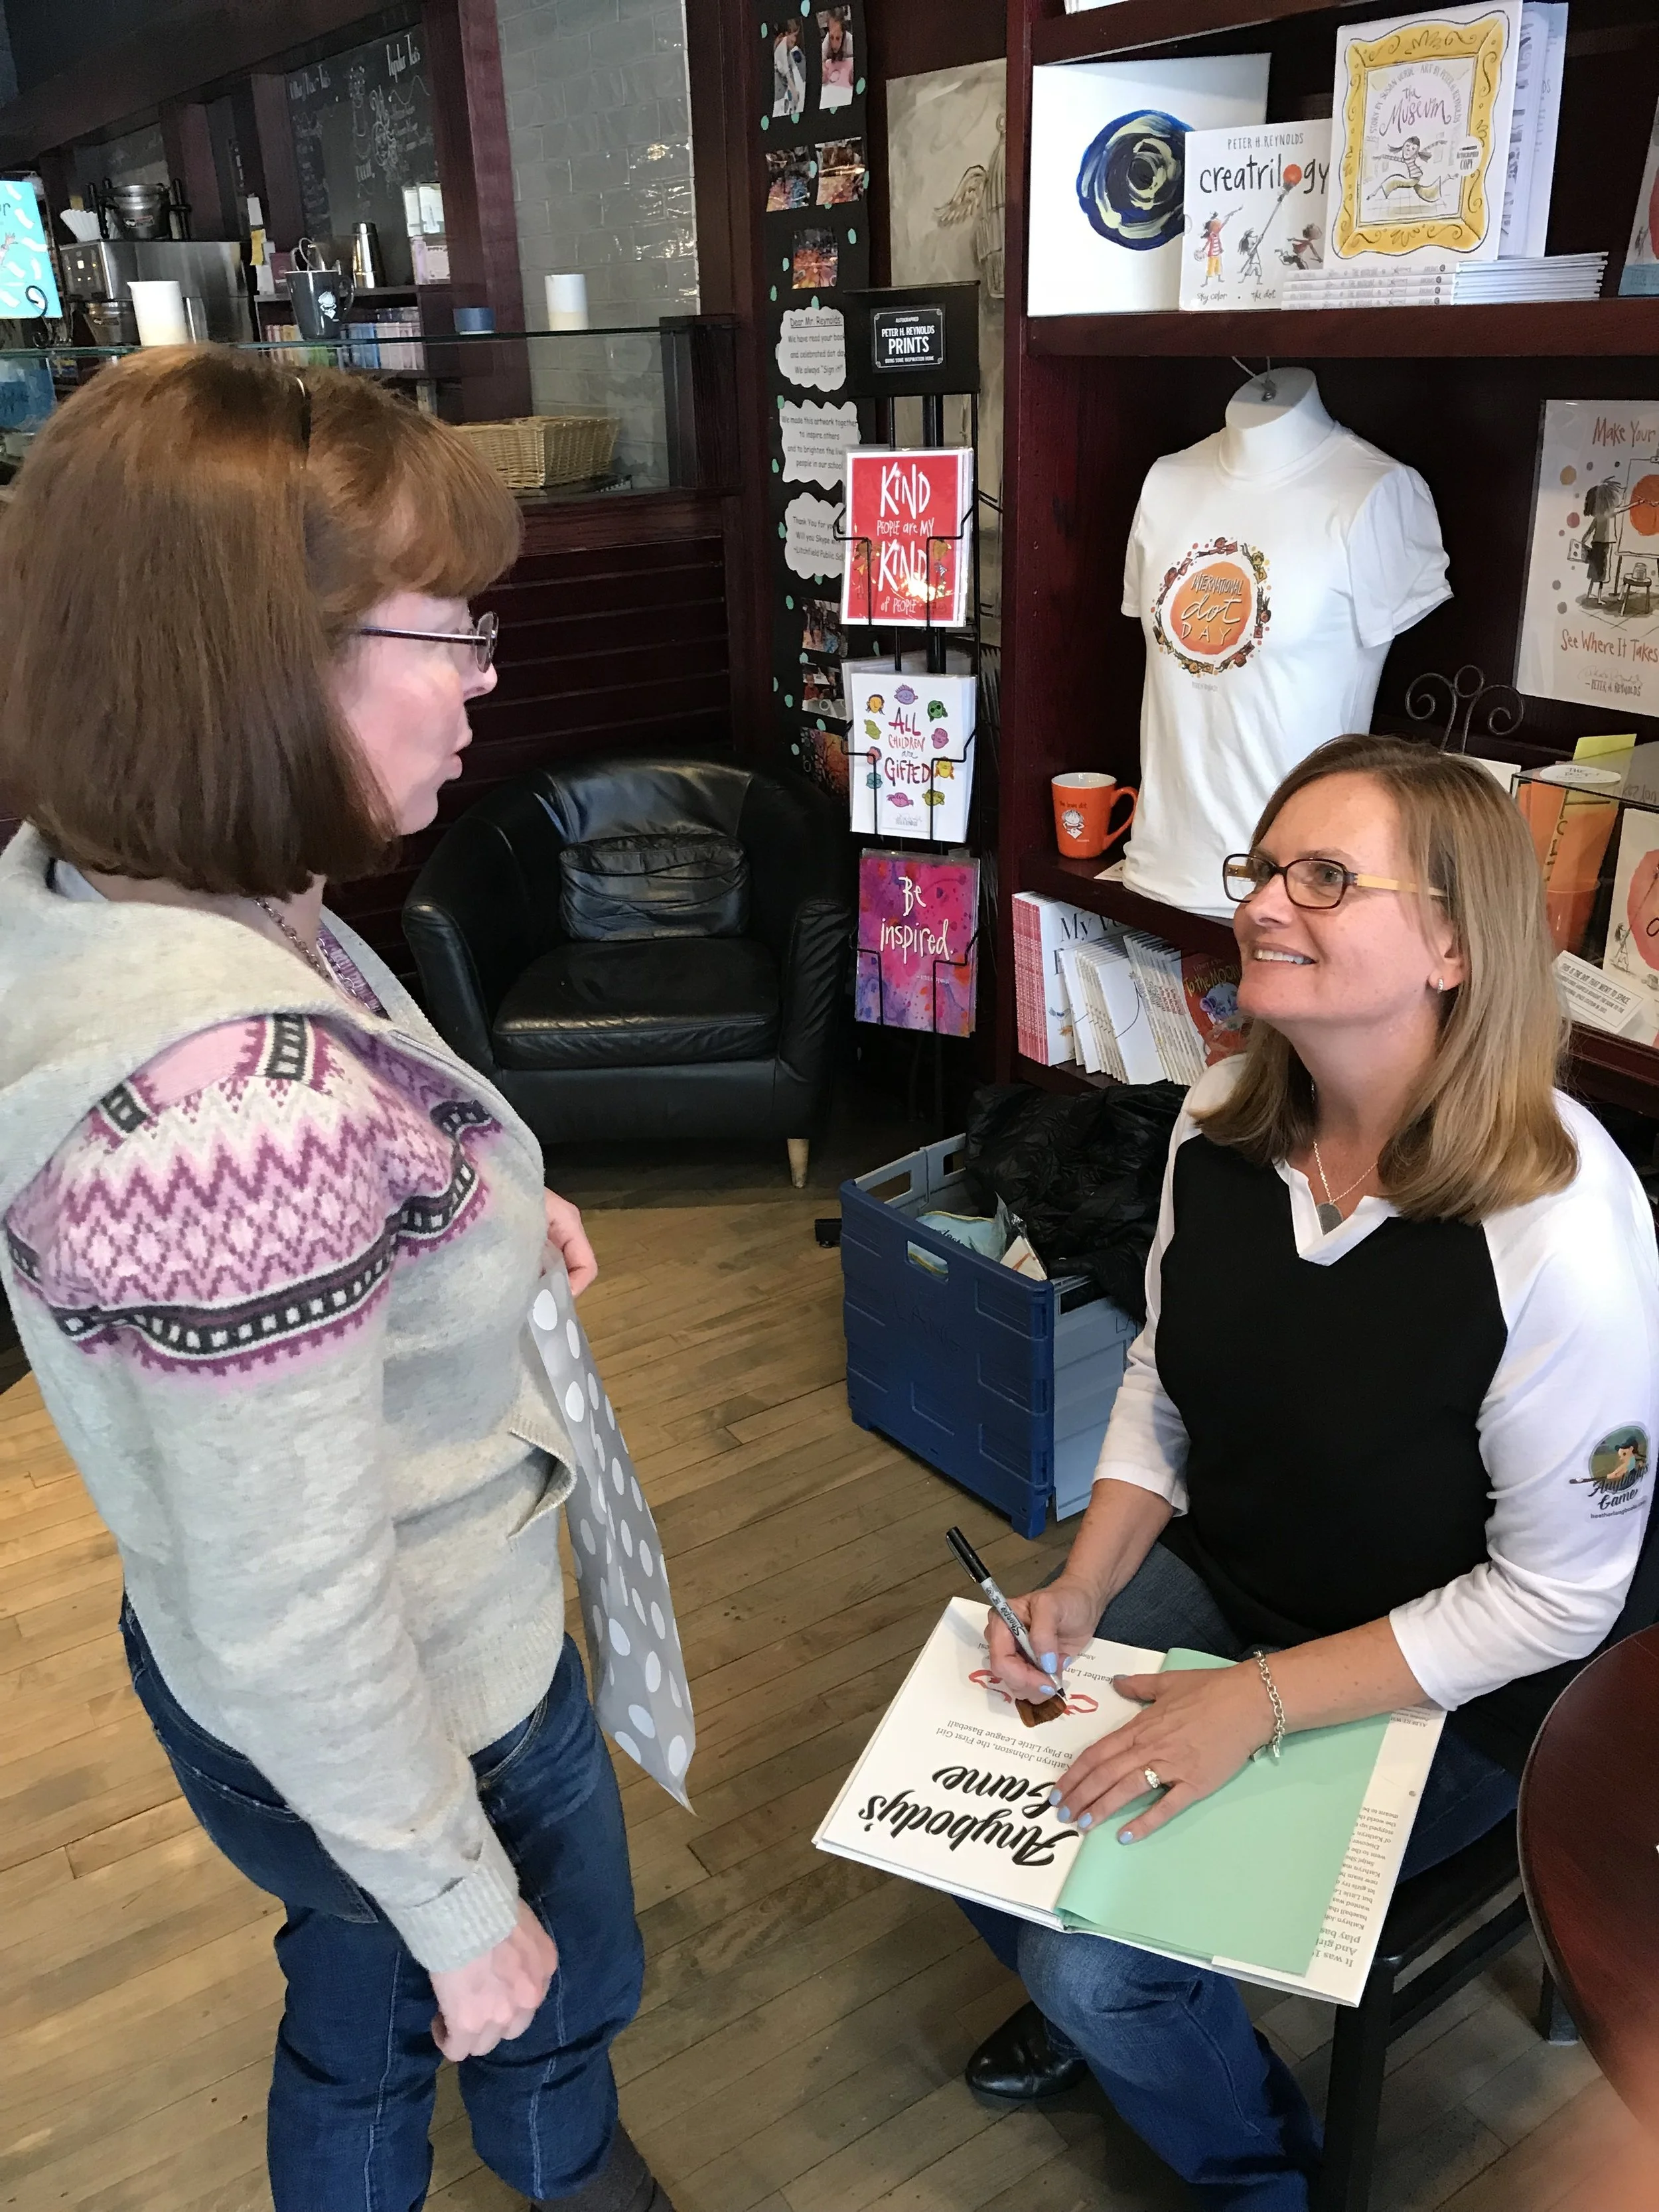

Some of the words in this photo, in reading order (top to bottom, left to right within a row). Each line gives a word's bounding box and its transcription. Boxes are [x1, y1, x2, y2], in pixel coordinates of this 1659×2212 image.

[1402, 85, 1421, 102] the
[1420, 64, 1433, 74] ART
[1439, 68, 1455, 87] PETER
[1452, 89, 1462, 123] REYNOLDS
[1370, 113, 1379, 133] STORY
[1375, 101, 1384, 110] BY
[1380, 78, 1398, 100] SUSAN
[1379, 98, 1452, 137] Museum
[1228, 137, 1252, 150] PETER
[1264, 133, 1304, 149] REYNOLDS
[1459, 159, 1473, 171] COPY
[1200, 153, 1331, 194] creatrilogy
[1210, 291, 1228, 301] color
[1251, 289, 1262, 301] the
[1263, 288, 1276, 299] dot
[790, 317, 804, 327] Dear
[881, 328, 899, 337] PETER
[906, 325, 935, 335] REYNOLDS
[889, 336, 929, 354] PRINTS
[804, 366, 820, 376] always
[804, 416, 813, 425] this
[835, 419, 857, 428] together
[806, 431, 822, 440] inspire
[1592, 416, 1626, 447] Make
[1630, 420, 1656, 448] Your
[804, 445, 824, 455] brighten
[793, 516, 806, 525] Thank
[808, 518, 817, 528] You
[877, 520, 900, 536] PEOPLE
[902, 523, 918, 534] are
[920, 517, 934, 536] MY
[816, 534, 830, 545] Skype
[820, 550, 834, 560] Public
[1190, 573, 1244, 596] INTERNATIONAL
[881, 596, 891, 612] of
[893, 597, 916, 614] PEOPLE
[1181, 593, 1242, 624] dot
[1561, 628, 1579, 651] See
[1581, 630, 1615, 655] Where
[1617, 637, 1627, 658] It
[1630, 638, 1658, 663] Takes
[1615, 682, 1641, 697] REYNOLDS
[888, 707, 921, 737] ALL
[888, 735, 926, 752] CHILDREN
[901, 749, 918, 759] are
[899, 876, 926, 916] Be
[1060, 913, 1092, 942] My
[881, 918, 954, 964] inspired.
[1183, 976, 1195, 997] To
[1194, 974, 1211, 994] the
[1209, 964, 1242, 988] MOON
[1573, 969, 1583, 978] THE
[1588, 978, 1601, 989] THAT
[1599, 983, 1612, 994] WENT
[1616, 993, 1631, 1005] SPACE
[1598, 1489, 1638, 1510] Game
[946, 1720, 984, 1736] Baseball
[1404, 1718, 1426, 1728] ALBERT
[936, 1728, 954, 1738] Girl
[954, 1732, 975, 1745] First
[985, 1731, 1017, 1746] League
[976, 1737, 991, 1748] the
[1017, 1740, 1043, 1753] Little
[993, 1743, 1035, 1761] Johnston,
[1043, 1746, 1062, 1758] Play
[932, 1765, 1056, 1819] Game
[1378, 1810, 1399, 1819] meant
[858, 1789, 1079, 1866] Anybody's
[1368, 1825, 1394, 1835] stepped
[1357, 1831, 1383, 1843] Kathryn
[1352, 1839, 1380, 1850] Discover
[1347, 1873, 1364, 1881] team
[1354, 1866, 1381, 1878] Kathryn
[1343, 1891, 1361, 1900] Little
[1346, 1901, 1370, 1911] wanted
[1340, 1909, 1368, 1921] baseball
[1337, 1917, 1364, 1930] Kathryn
[1338, 1931, 1361, 1944] play
[1334, 1943, 1358, 1956] And
[1323, 1953, 1342, 1962] was
[1345, 1958, 1354, 1968] It
